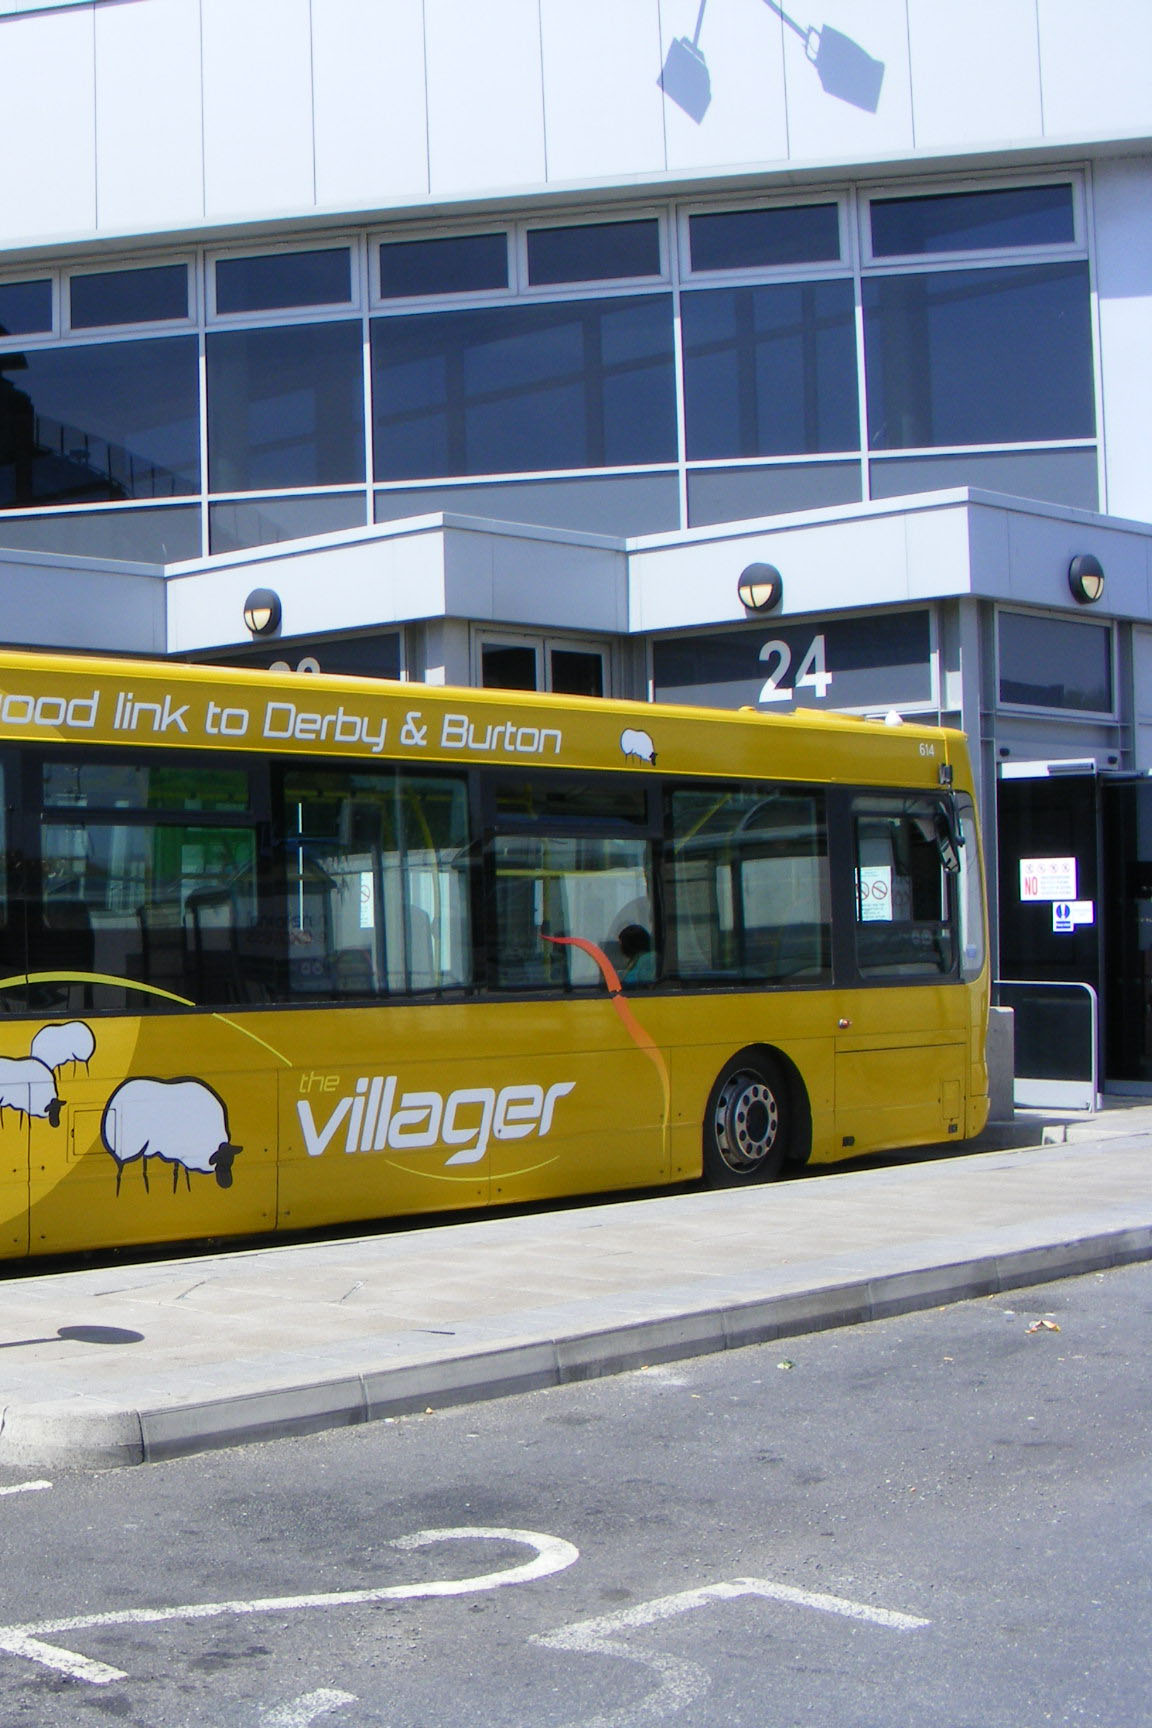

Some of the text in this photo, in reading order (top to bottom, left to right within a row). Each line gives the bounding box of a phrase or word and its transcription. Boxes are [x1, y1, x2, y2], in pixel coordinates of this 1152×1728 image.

[758, 634, 833, 703] 24
[113, 690, 190, 734] link
[205, 700, 250, 736] to
[262, 701, 388, 755] Derby
[399, 709, 427, 748] &
[440, 713, 562, 755] Burton
[919, 743, 935, 757] 614
[1024, 876, 1038, 896] NO
[298, 1071, 341, 1093] the
[297, 1075, 577, 1166] villager
